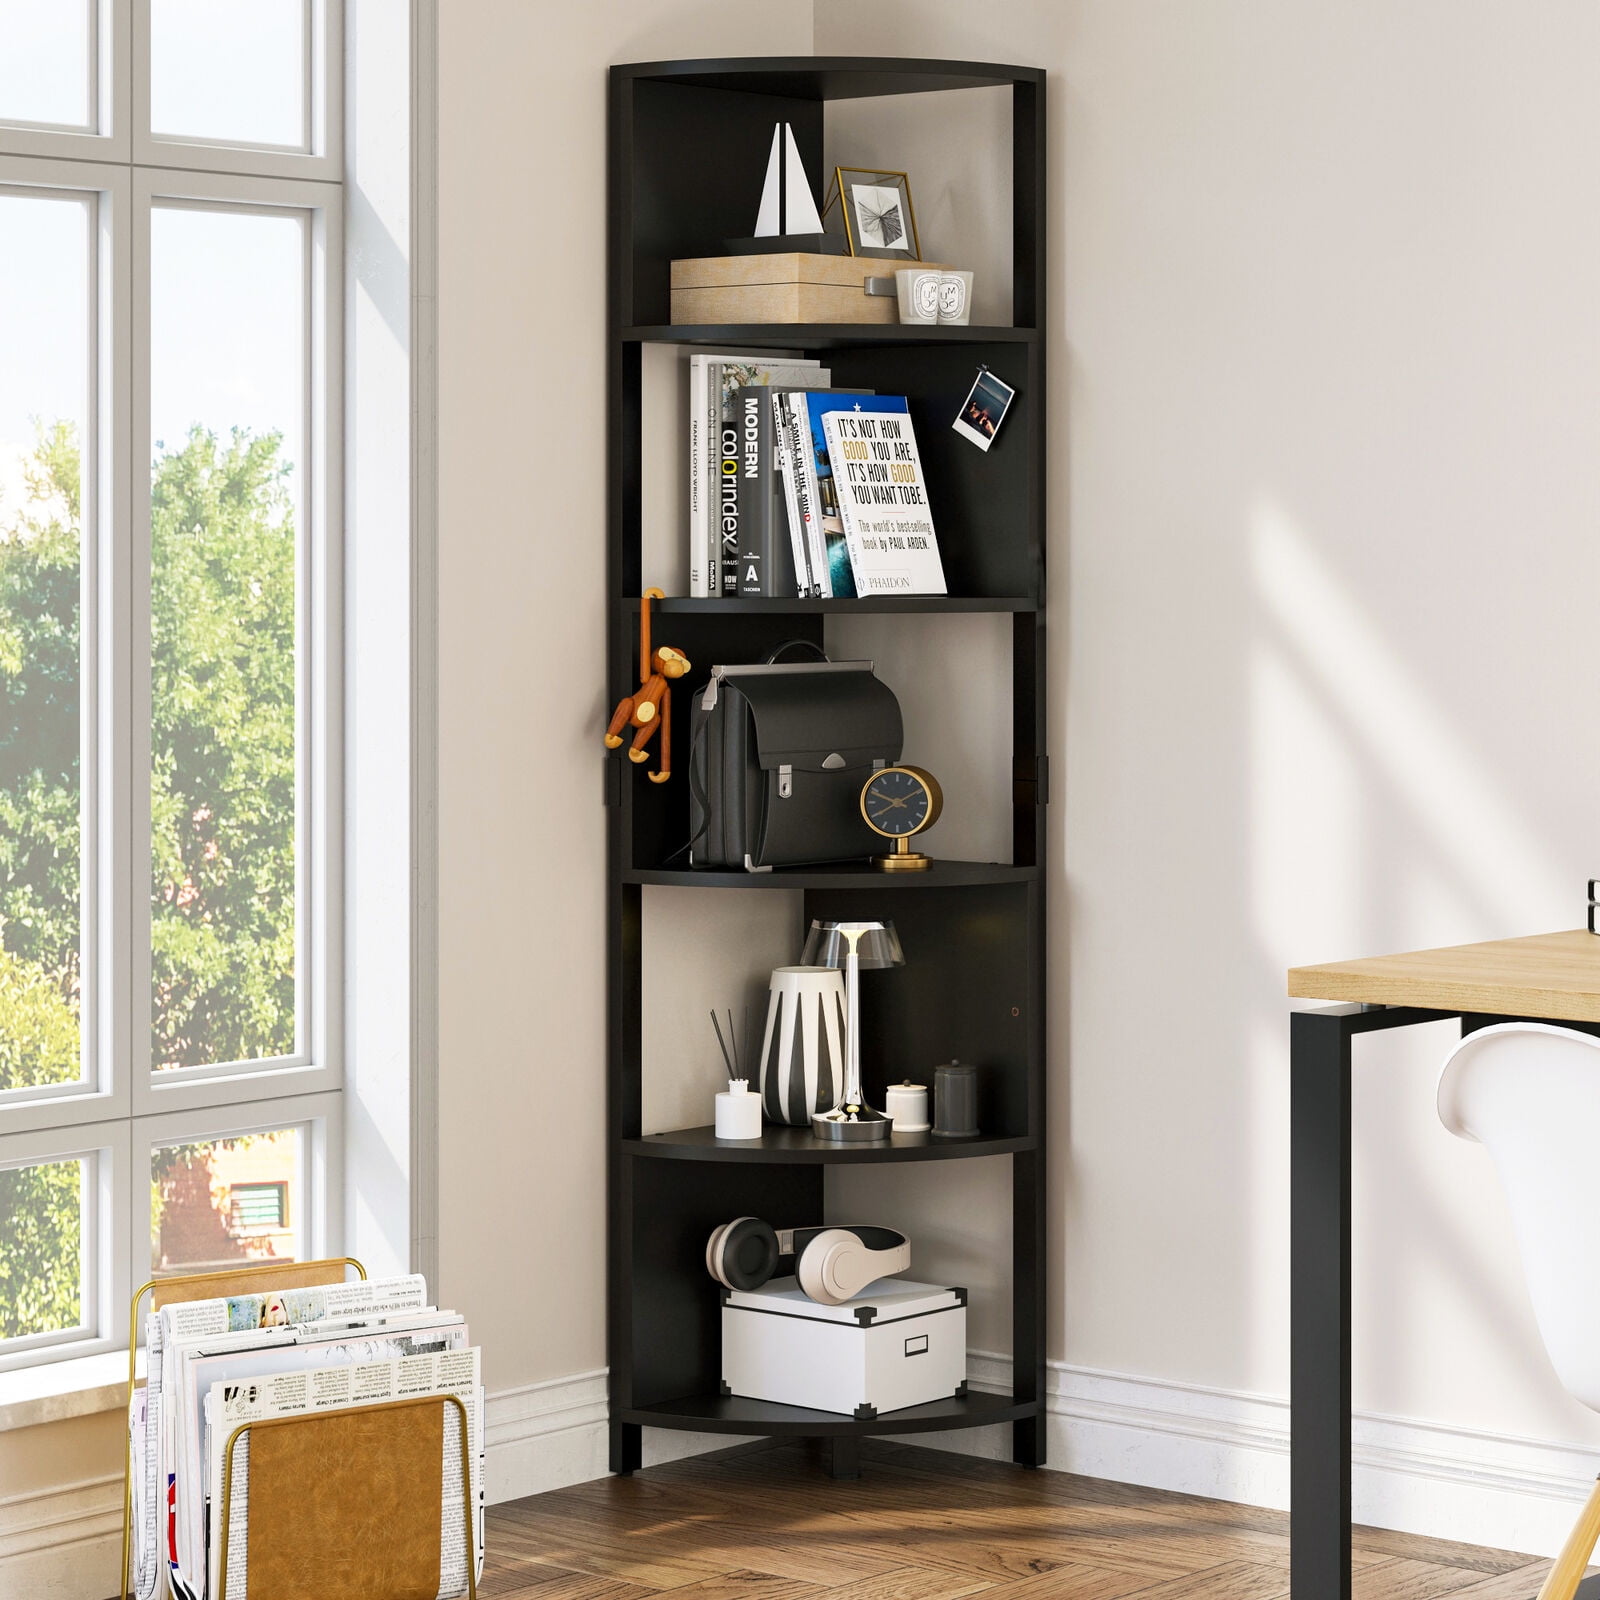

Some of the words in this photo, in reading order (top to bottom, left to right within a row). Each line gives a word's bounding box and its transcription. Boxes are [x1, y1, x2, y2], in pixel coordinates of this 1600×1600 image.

[745, 398, 758, 478] MODERN
[837, 418, 857, 438] IT'S
[858, 419, 877, 438] NOT
[880, 420, 901, 439] HOW
[791, 423, 801, 454] SMILE
[842, 441, 868, 460] GOOD
[870, 442, 891, 461] YOU
[894, 442, 916, 464] ARE,
[797, 456, 804, 469] IN
[798, 471, 807, 490] THE
[846, 463, 866, 482] IT'S
[868, 463, 889, 482] HOW
[890, 464, 916, 483] GOOD
[851, 485, 871, 504] YOU
[871, 486, 897, 504] WANT
[802, 494, 811, 522] MIND
[858, 520, 870, 532] The
[872, 520, 895, 532] world's
[896, 520, 932, 535] best-selling
[862, 537, 878, 549] book
[879, 537, 888, 552] by
[888, 537, 906, 549] PAUL
[907, 537, 930, 549] ARDEN.
[745, 564, 758, 581] A
[869, 577, 910, 588] PHAIDON
